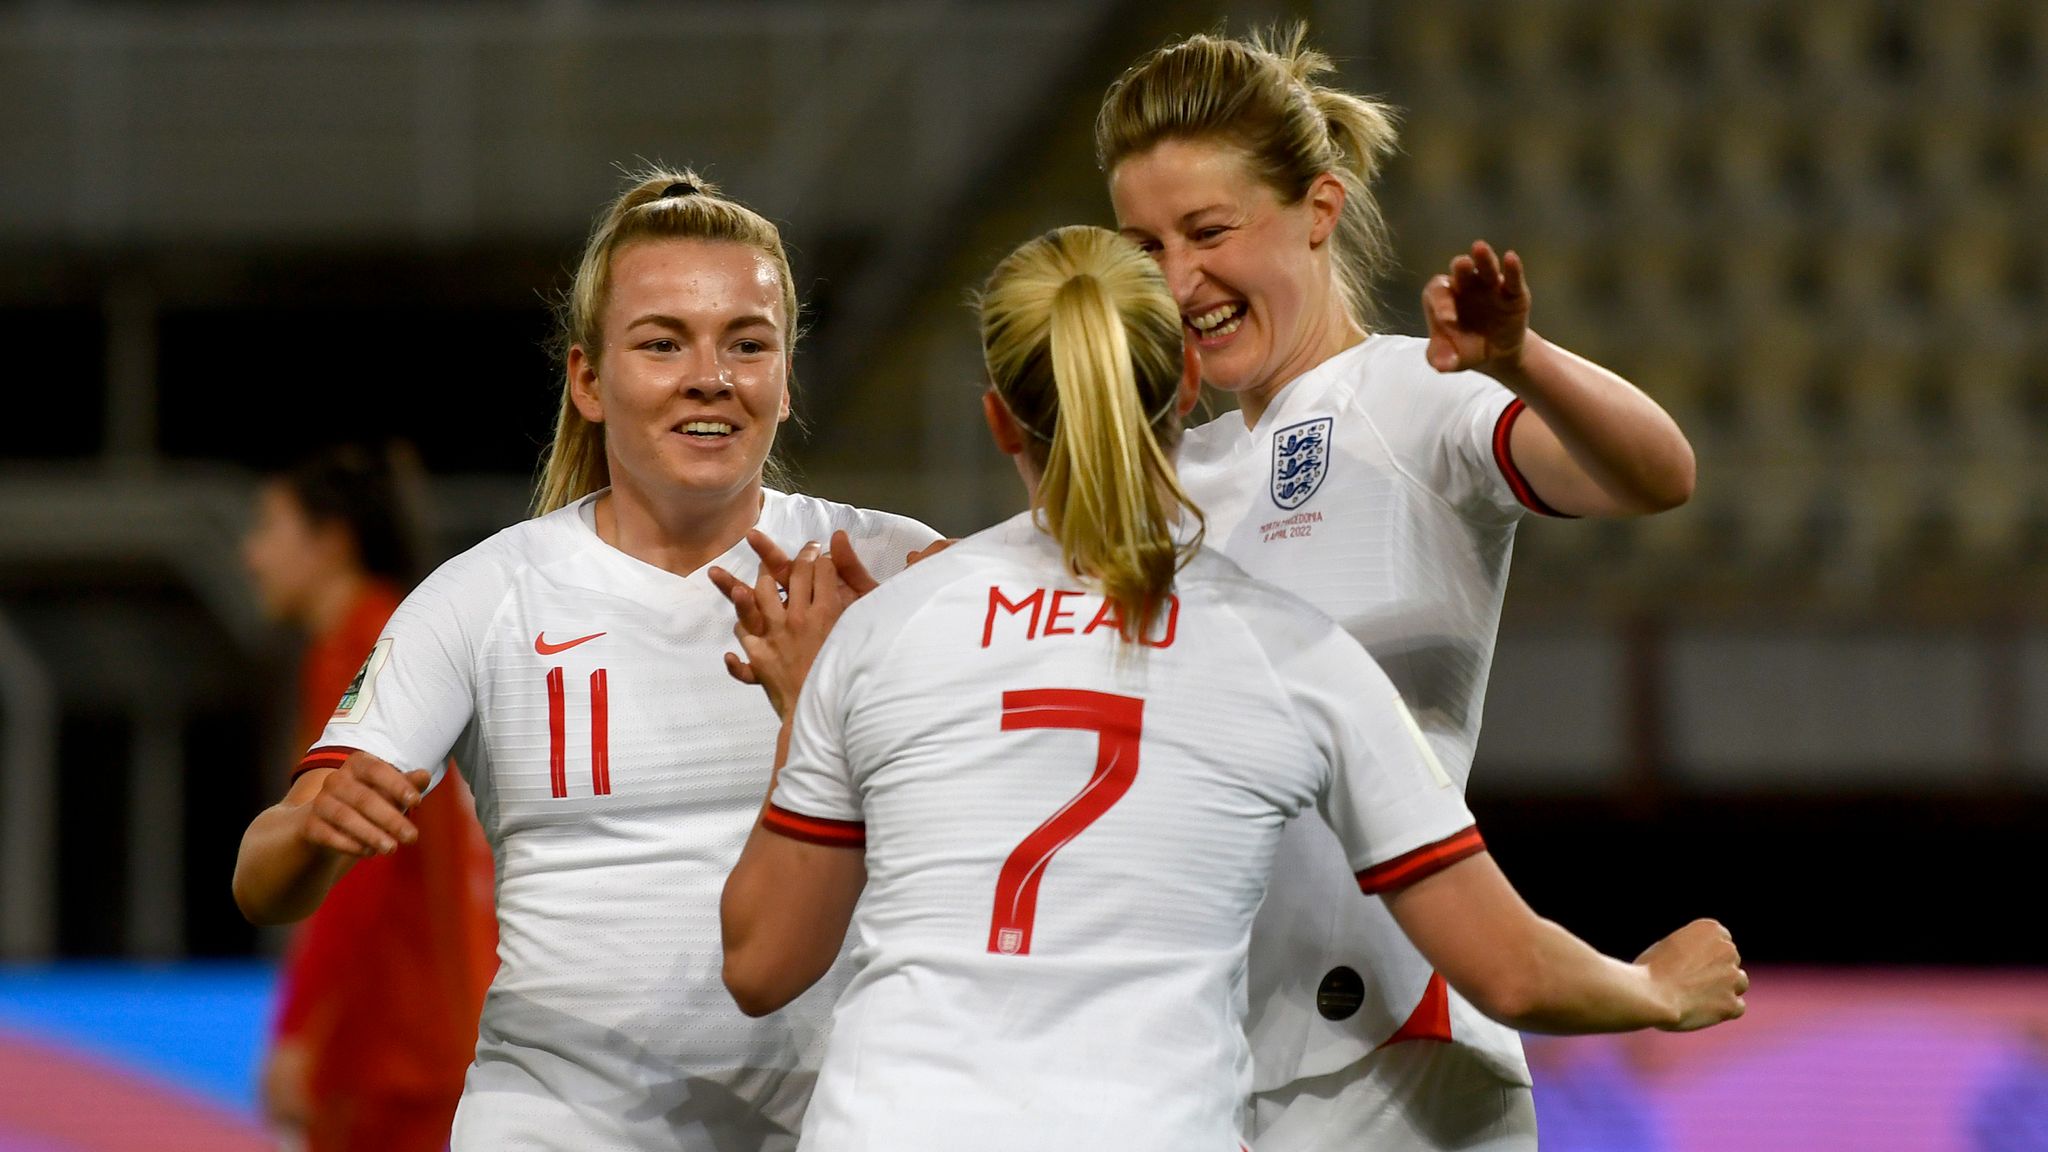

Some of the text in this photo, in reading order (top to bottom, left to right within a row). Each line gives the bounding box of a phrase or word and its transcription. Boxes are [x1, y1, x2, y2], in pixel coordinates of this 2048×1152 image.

[1290, 525, 1312, 538] 2022
[546, 666, 611, 798] 11
[987, 688, 1145, 955] 7
